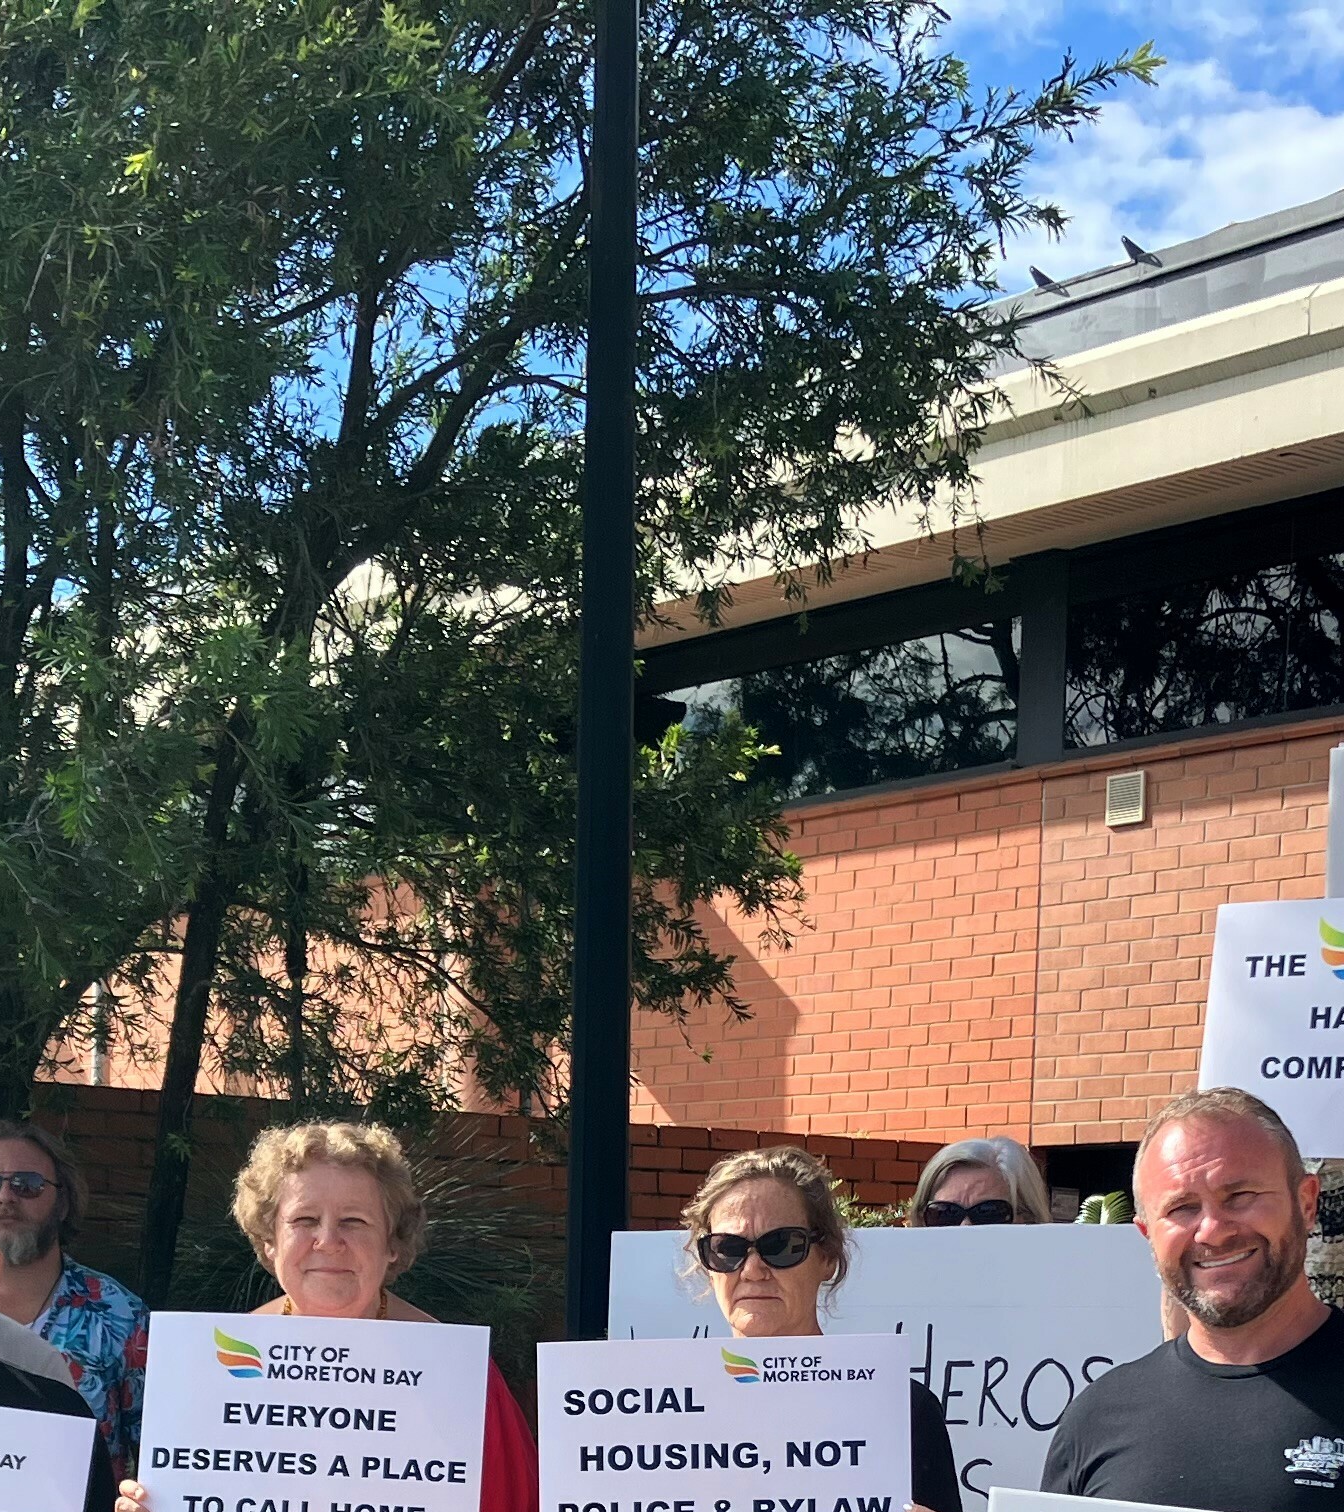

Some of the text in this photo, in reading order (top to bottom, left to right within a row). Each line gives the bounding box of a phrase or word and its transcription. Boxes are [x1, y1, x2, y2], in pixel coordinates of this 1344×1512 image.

[1245, 953, 1307, 978] THE
[268, 1344, 350, 1363] CITY OF
[762, 1355, 822, 1369] CITY OF
[267, 1363, 423, 1387] MORETON BAY
[763, 1368, 876, 1383] MORETON BAY
[563, 1387, 705, 1416] SOCIAL
[223, 1402, 397, 1432] EVERYONE
[151, 1447, 467, 1484] DESERVES A PLACE
[579, 1439, 867, 1475] HOUSING, NOT
